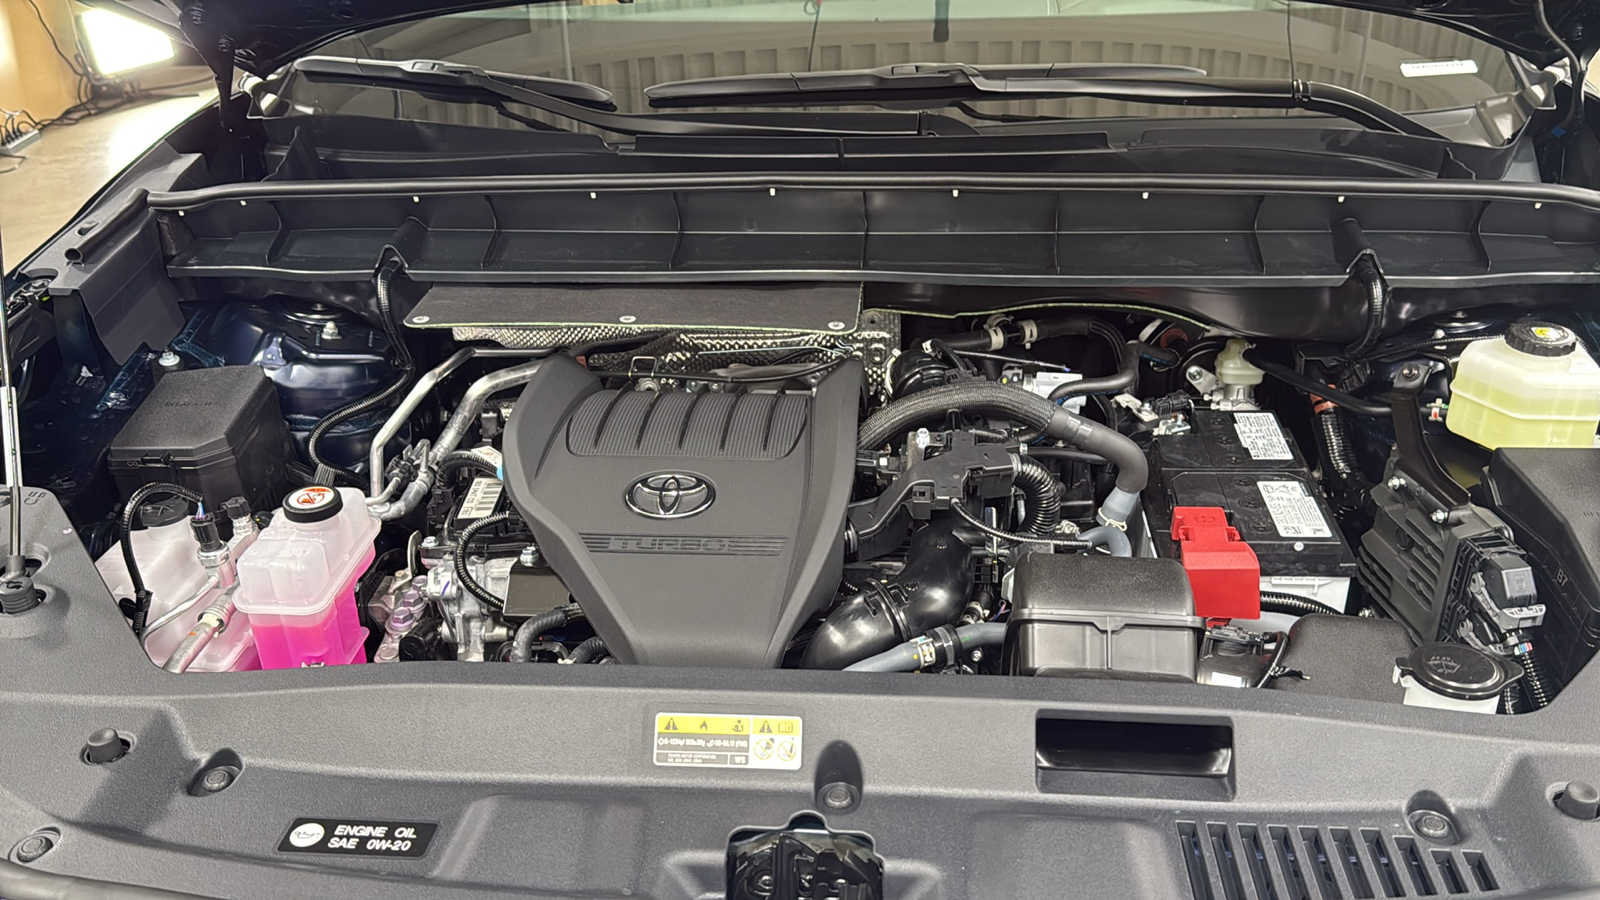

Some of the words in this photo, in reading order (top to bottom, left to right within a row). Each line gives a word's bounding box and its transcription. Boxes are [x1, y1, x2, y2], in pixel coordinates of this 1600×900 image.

[613, 537, 726, 551] TURBO
[334, 825, 388, 838] ENGINE
[394, 827, 417, 839] OIL
[328, 837, 359, 849] SAE
[366, 839, 412, 852] 0W-20
